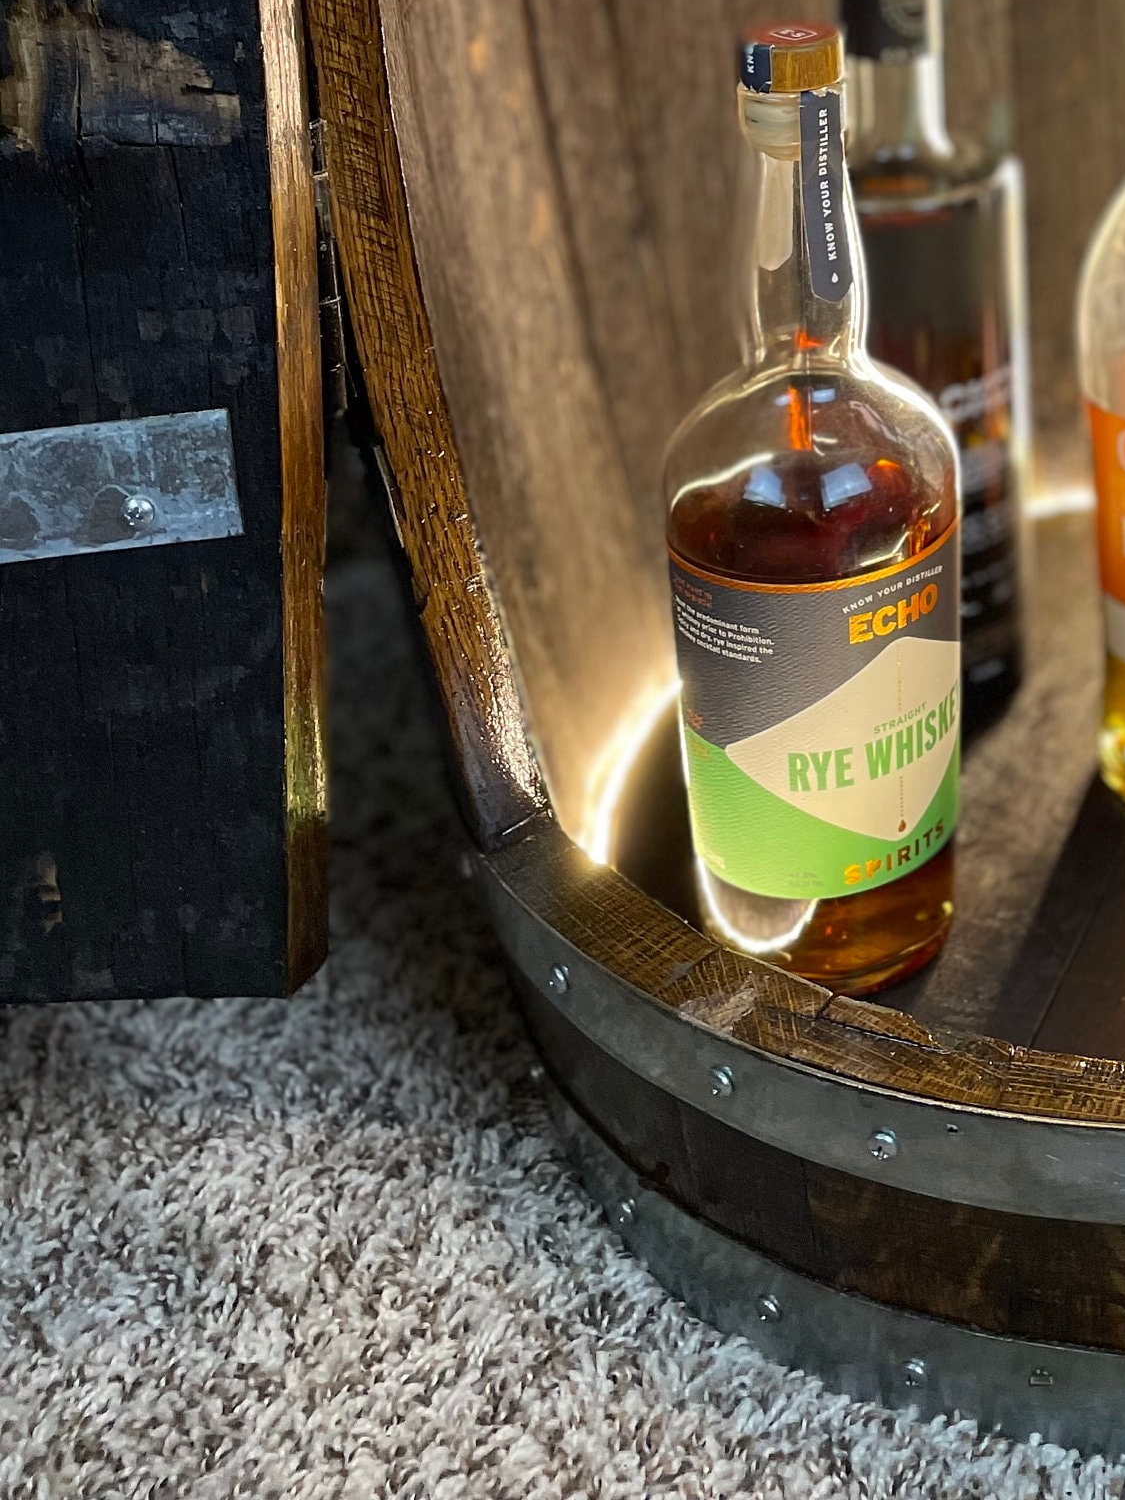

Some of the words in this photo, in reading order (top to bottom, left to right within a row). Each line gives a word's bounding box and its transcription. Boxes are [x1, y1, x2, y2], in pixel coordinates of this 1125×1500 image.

[818, 107, 828, 177] DISTILLER
[820, 181, 832, 218] YOUR
[826, 222, 837, 261] KNOW
[842, 594, 873, 614] KNOW
[877, 581, 903, 598] YOUR
[906, 565, 943, 586] DISTILLER
[739, 624, 760, 634] form
[849, 583, 938, 644] ECHO
[713, 637, 725, 646] rye
[726, 640, 757, 654] inspired
[759, 645, 774, 655] the
[718, 629, 727, 638] to
[787, 747, 855, 792] RYE
[864, 679, 958, 780] WHISKE
[873, 701, 927, 735] STRAIGHT
[844, 818, 945, 885] SPIRITS
